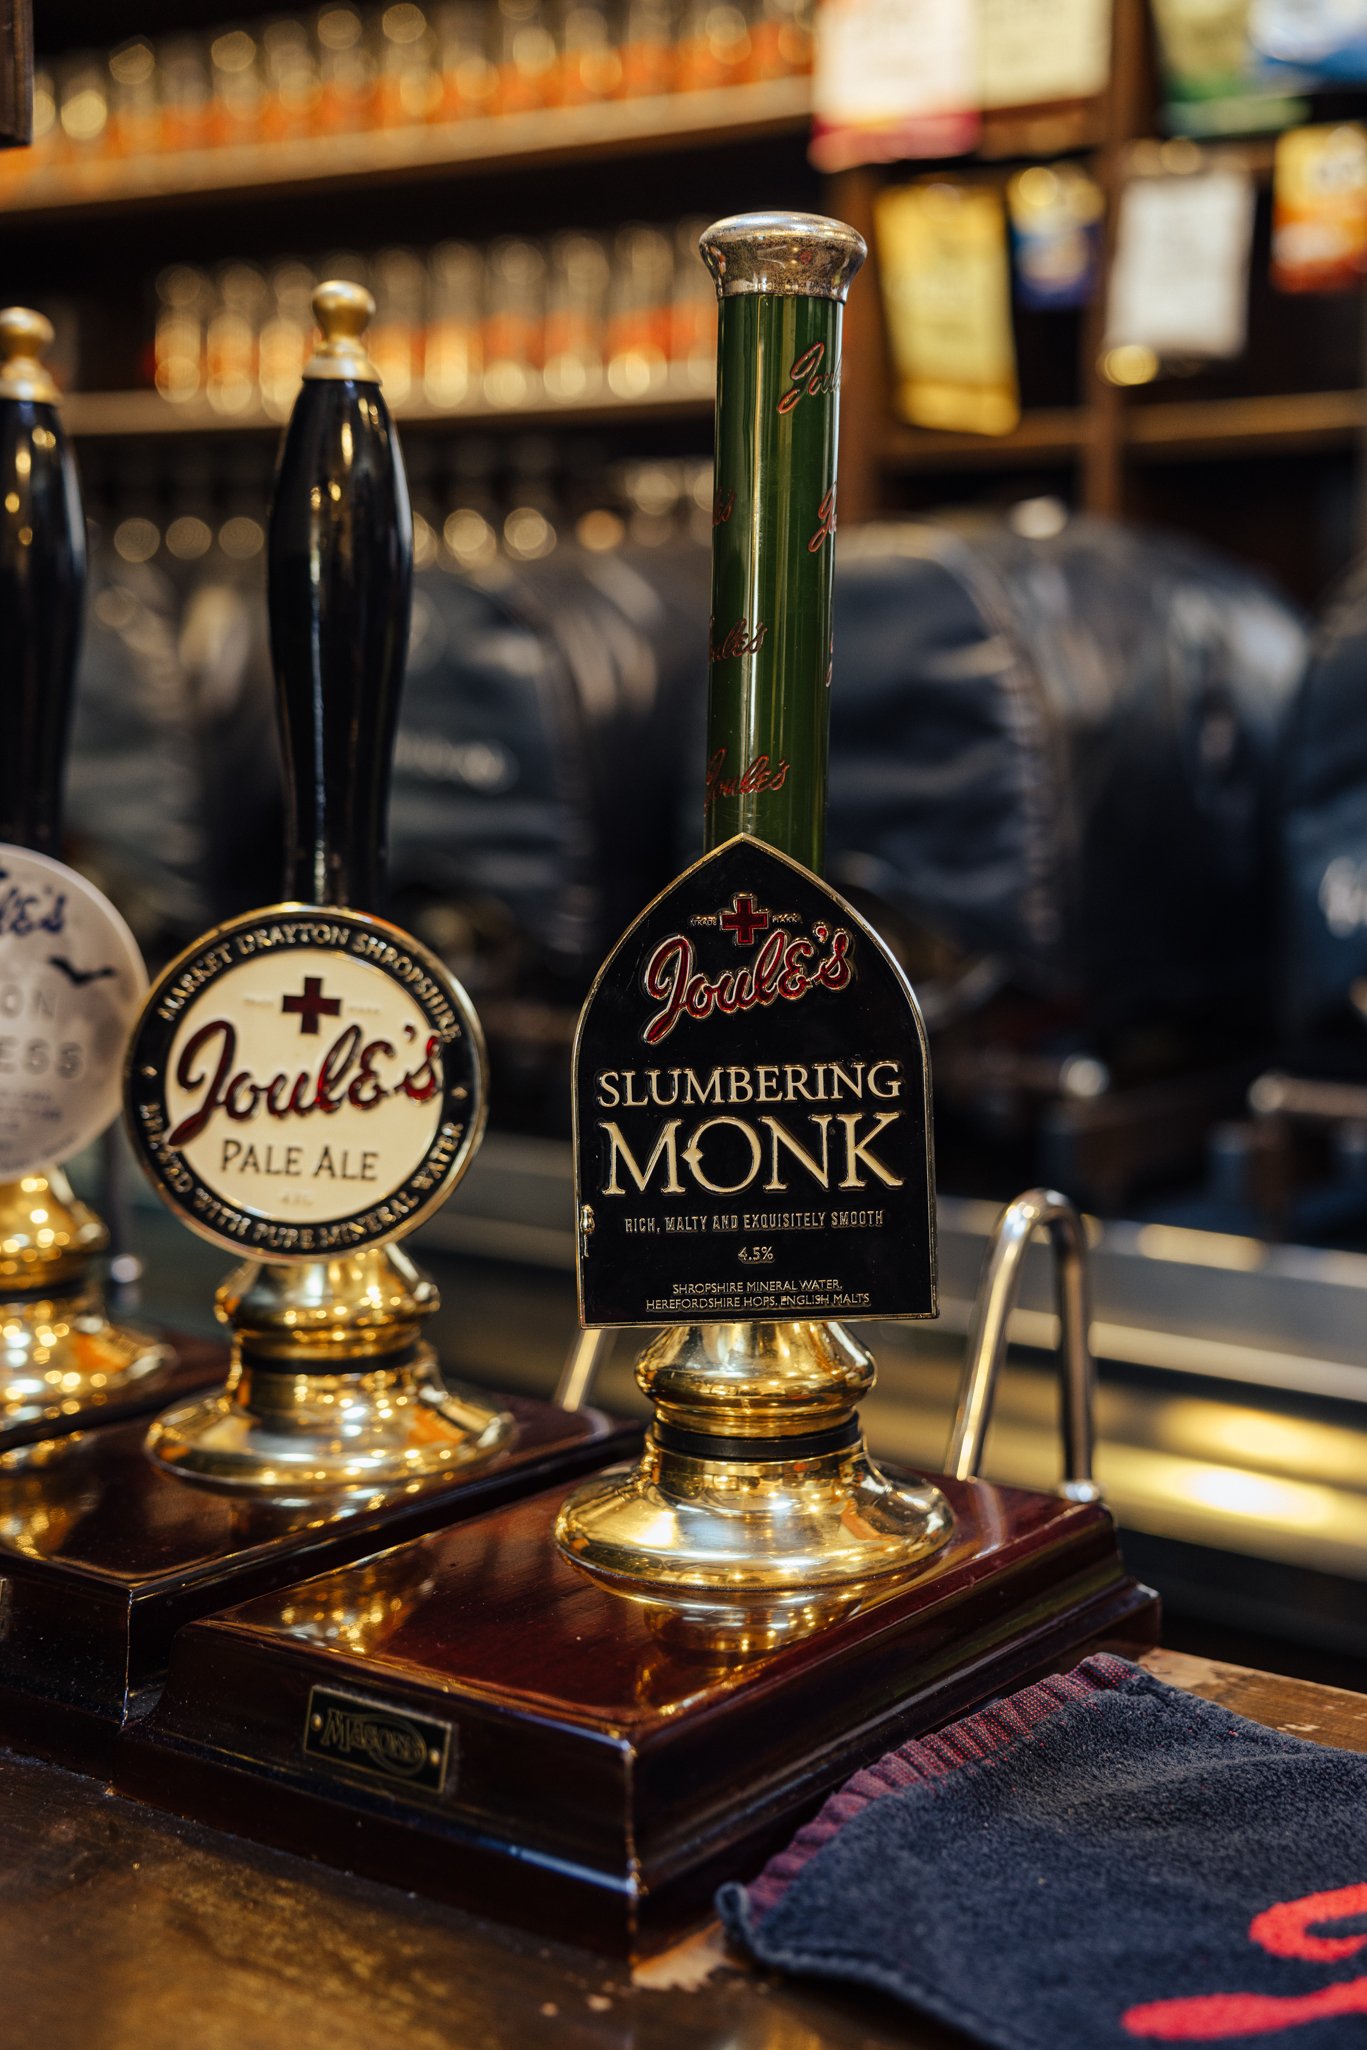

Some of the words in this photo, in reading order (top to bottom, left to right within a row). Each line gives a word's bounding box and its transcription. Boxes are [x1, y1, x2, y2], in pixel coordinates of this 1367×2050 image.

[235, 923, 350, 955] DRAYTON
[353, 933, 463, 1044] SHROPSHIRE
[597, 1060, 902, 1108] SLUMBERING
[220, 1137, 302, 1177] PALE
[313, 1145, 380, 1182] ALE
[599, 1111, 904, 1196] MONK
[625, 1217, 661, 1234] RICH,
[664, 1215, 708, 1233] MALTY
[712, 1214, 739, 1231] AND
[743, 1211, 826, 1230] EXQUISITELY
[831, 1210, 884, 1228] SMOOTH
[737, 1246, 774, 1264] 4.5%
[645, 1296, 741, 1311] HEREFORDSHIRE
[780, 1294, 830, 1308] ENGLISH
[833, 1292, 871, 1306] MALTS
[672, 1281, 744, 1295] SHROPSHIRE
[746, 1280, 798, 1293] MINERAL
